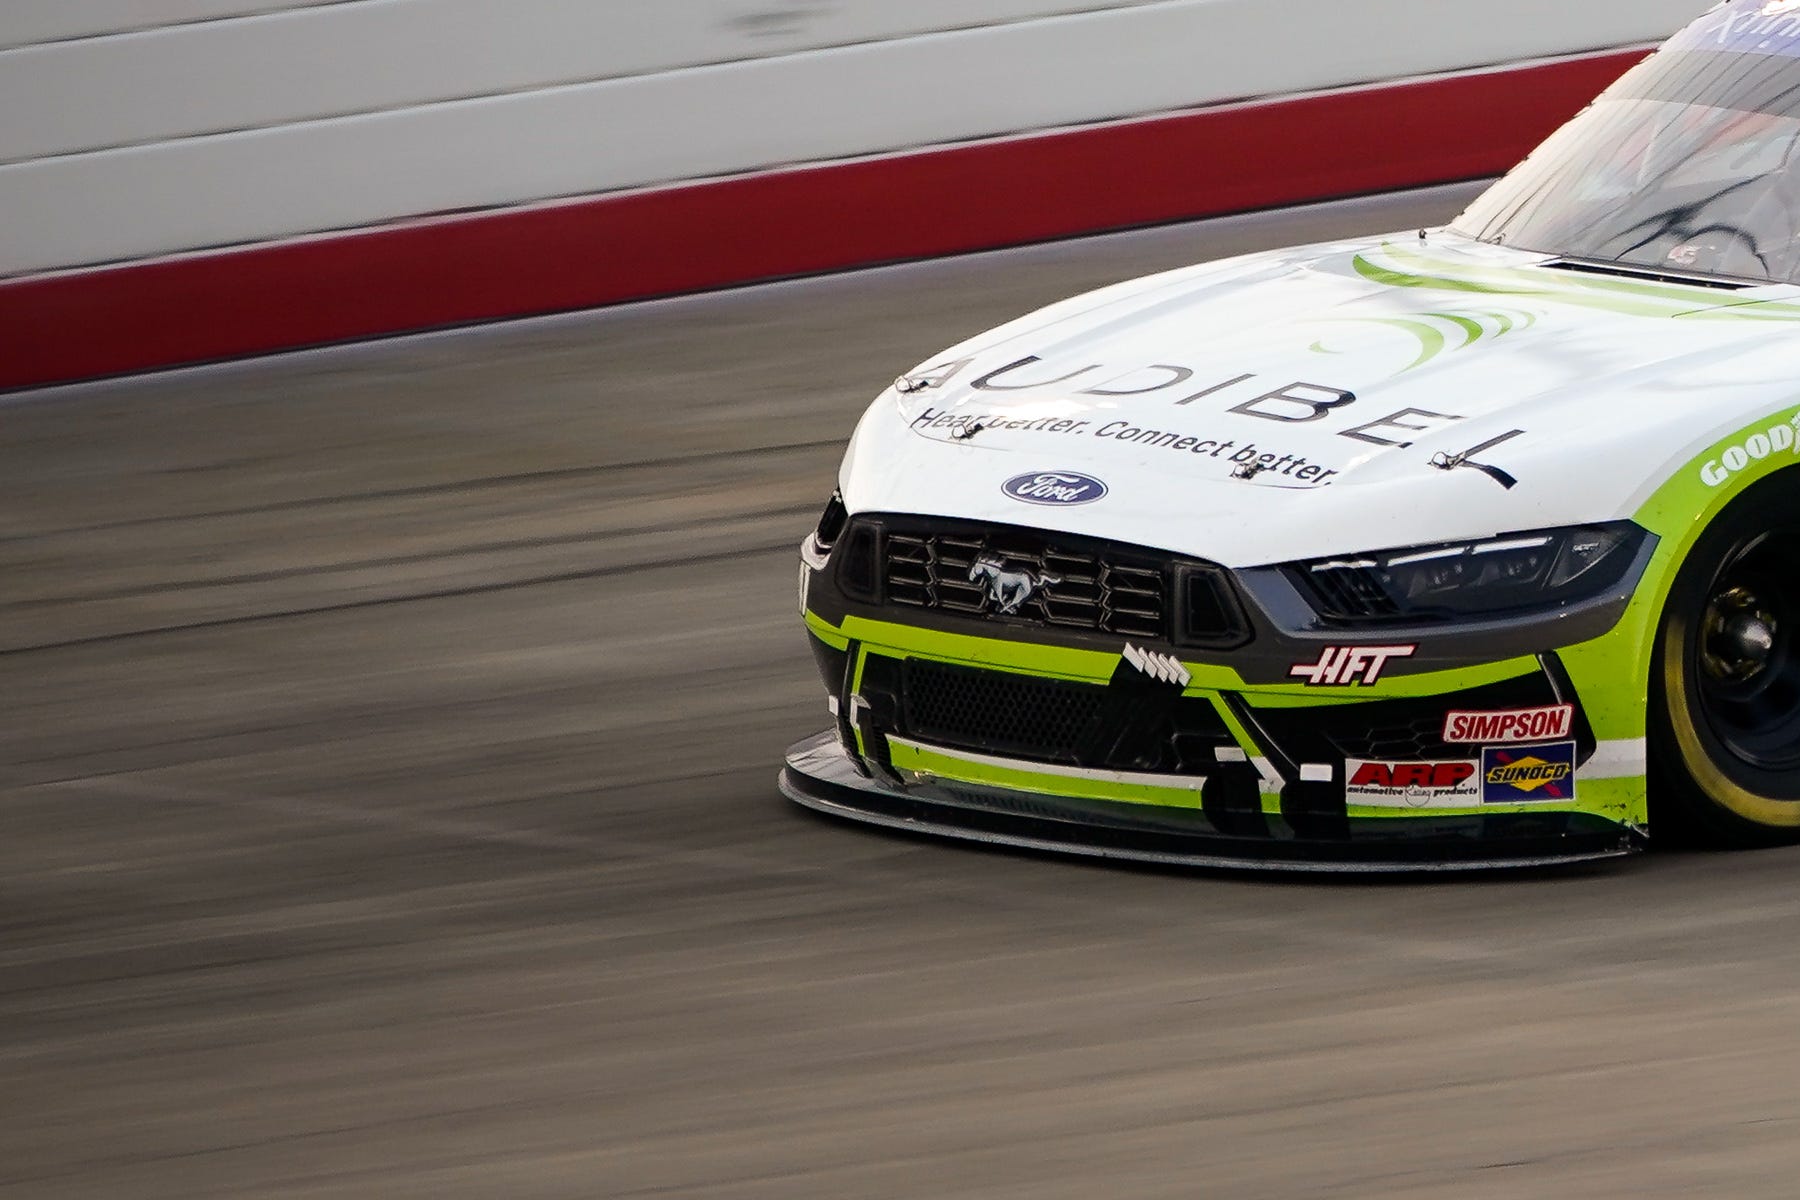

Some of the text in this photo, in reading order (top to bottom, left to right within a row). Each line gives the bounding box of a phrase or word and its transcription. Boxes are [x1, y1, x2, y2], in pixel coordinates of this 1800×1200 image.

[1095, 420, 1234, 458] Connect
[1018, 473, 1092, 503] Ford
[1449, 708, 1566, 740] SIMPSON
[1348, 762, 1475, 788] ARP
[1490, 762, 1569, 783] SUNOCO
